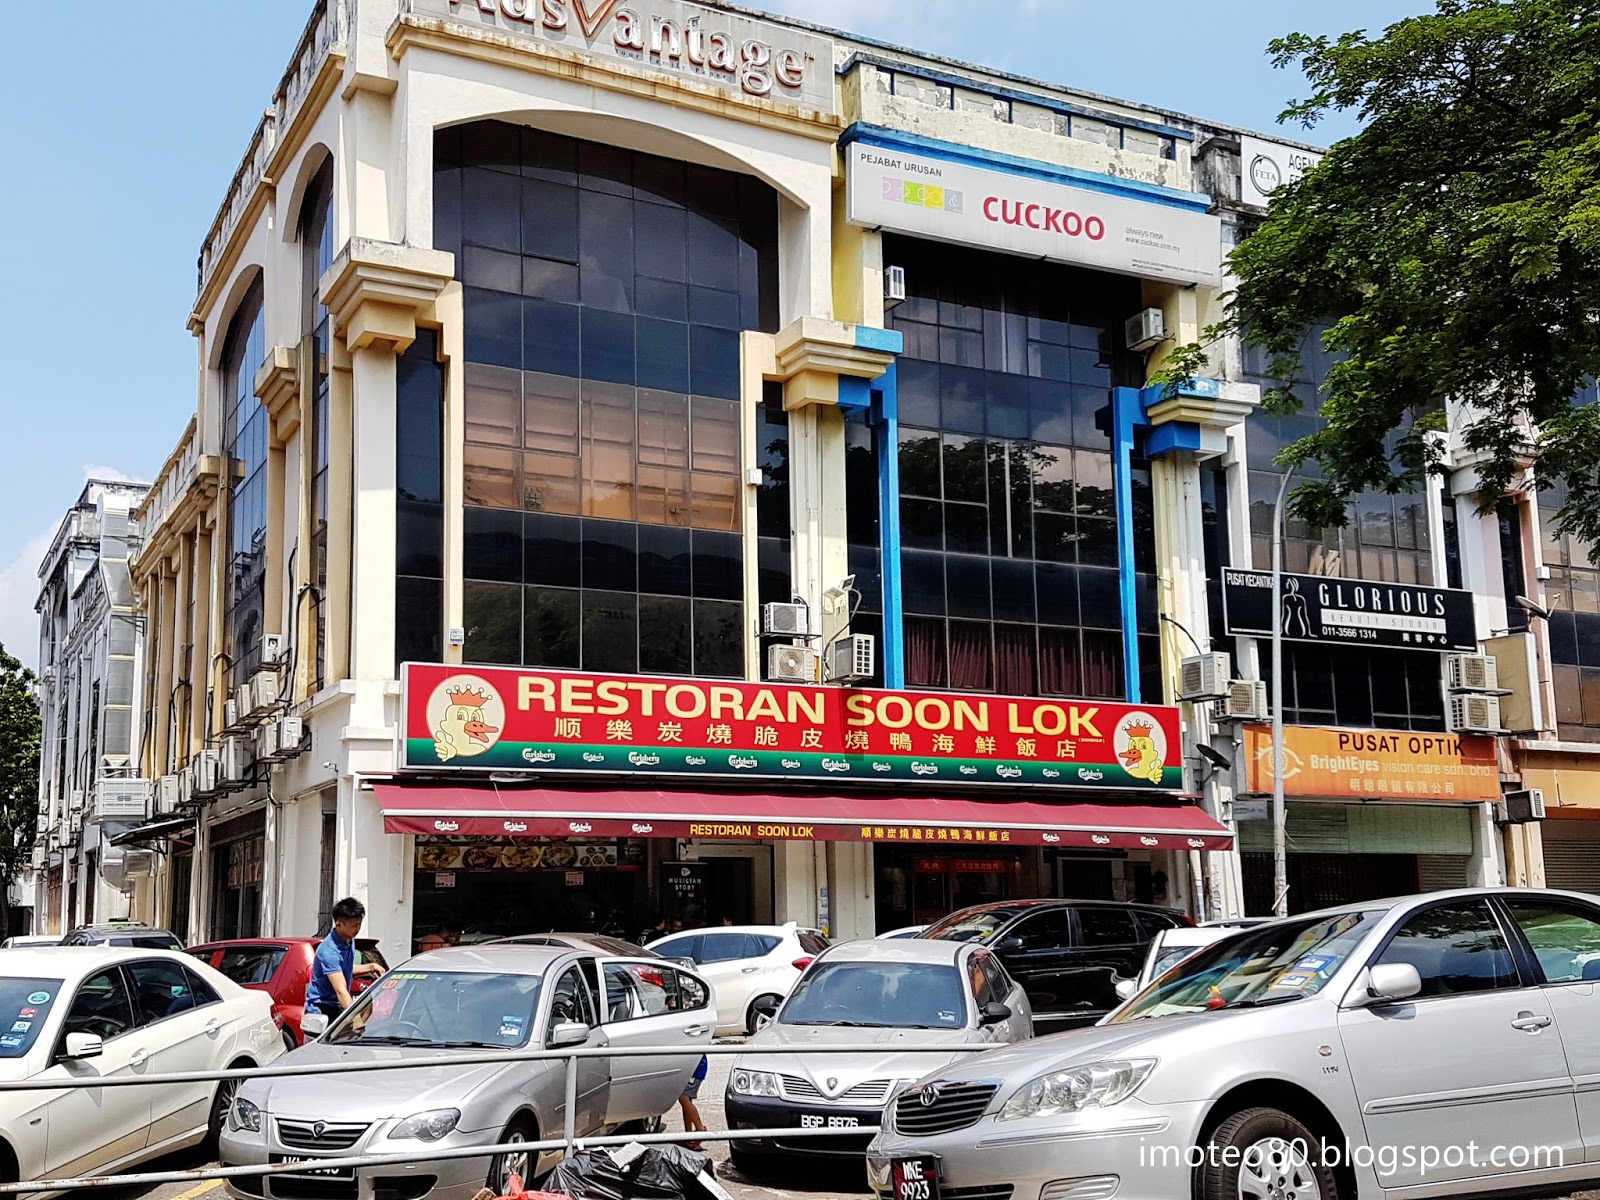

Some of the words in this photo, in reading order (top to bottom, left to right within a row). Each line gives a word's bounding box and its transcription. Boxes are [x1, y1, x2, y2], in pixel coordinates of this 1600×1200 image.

[860, 153, 902, 169] PEJABAT
[904, 162, 942, 177] URUSAN
[1255, 169, 1276, 182] FETA
[1125, 226, 1149, 239] always
[1150, 231, 1164, 241] new
[1125, 237, 1180, 253] www.cuckoo.com.my
[1226, 572, 1245, 586] PUSAT
[1318, 583, 1446, 616] GLORIOUS
[1331, 613, 1379, 625] BEAUTY
[1392, 618, 1438, 630] STUDIO
[1321, 626, 1357, 638] 011-3566
[1358, 629, 1377, 639] 1314
[1402, 633, 1447, 644] 美容中心
[517, 676, 825, 724] RESTORAN
[847, 694, 989, 732] SOON
[1008, 702, 1103, 738] LOK
[1339, 734, 1400, 753] PUSAT
[1408, 737, 1465, 756] OPTIK
[522, 748, 555, 763] Carlsberg
[628, 751, 660, 766] Carlsberg
[728, 754, 758, 769] Carlsberg
[822, 758, 850, 772] Carlsberg
[911, 761, 939, 775] Carlsberg
[996, 764, 1022, 778] Carlsberg
[1310, 754, 1380, 774] BrightEyes
[1383, 760, 1414, 773] vision
[1416, 764, 1441, 774] care
[1443, 763, 1467, 776] sdn.
[1469, 765, 1494, 777] bhd.
[690, 824, 751, 836] RESTORAN
[757, 825, 789, 837] SOON
[792, 826, 814, 837] LOK
[801, 1114, 824, 1128] BGP
[903, 1161, 923, 1180] WKE
[900, 1180, 930, 1200] 9923
